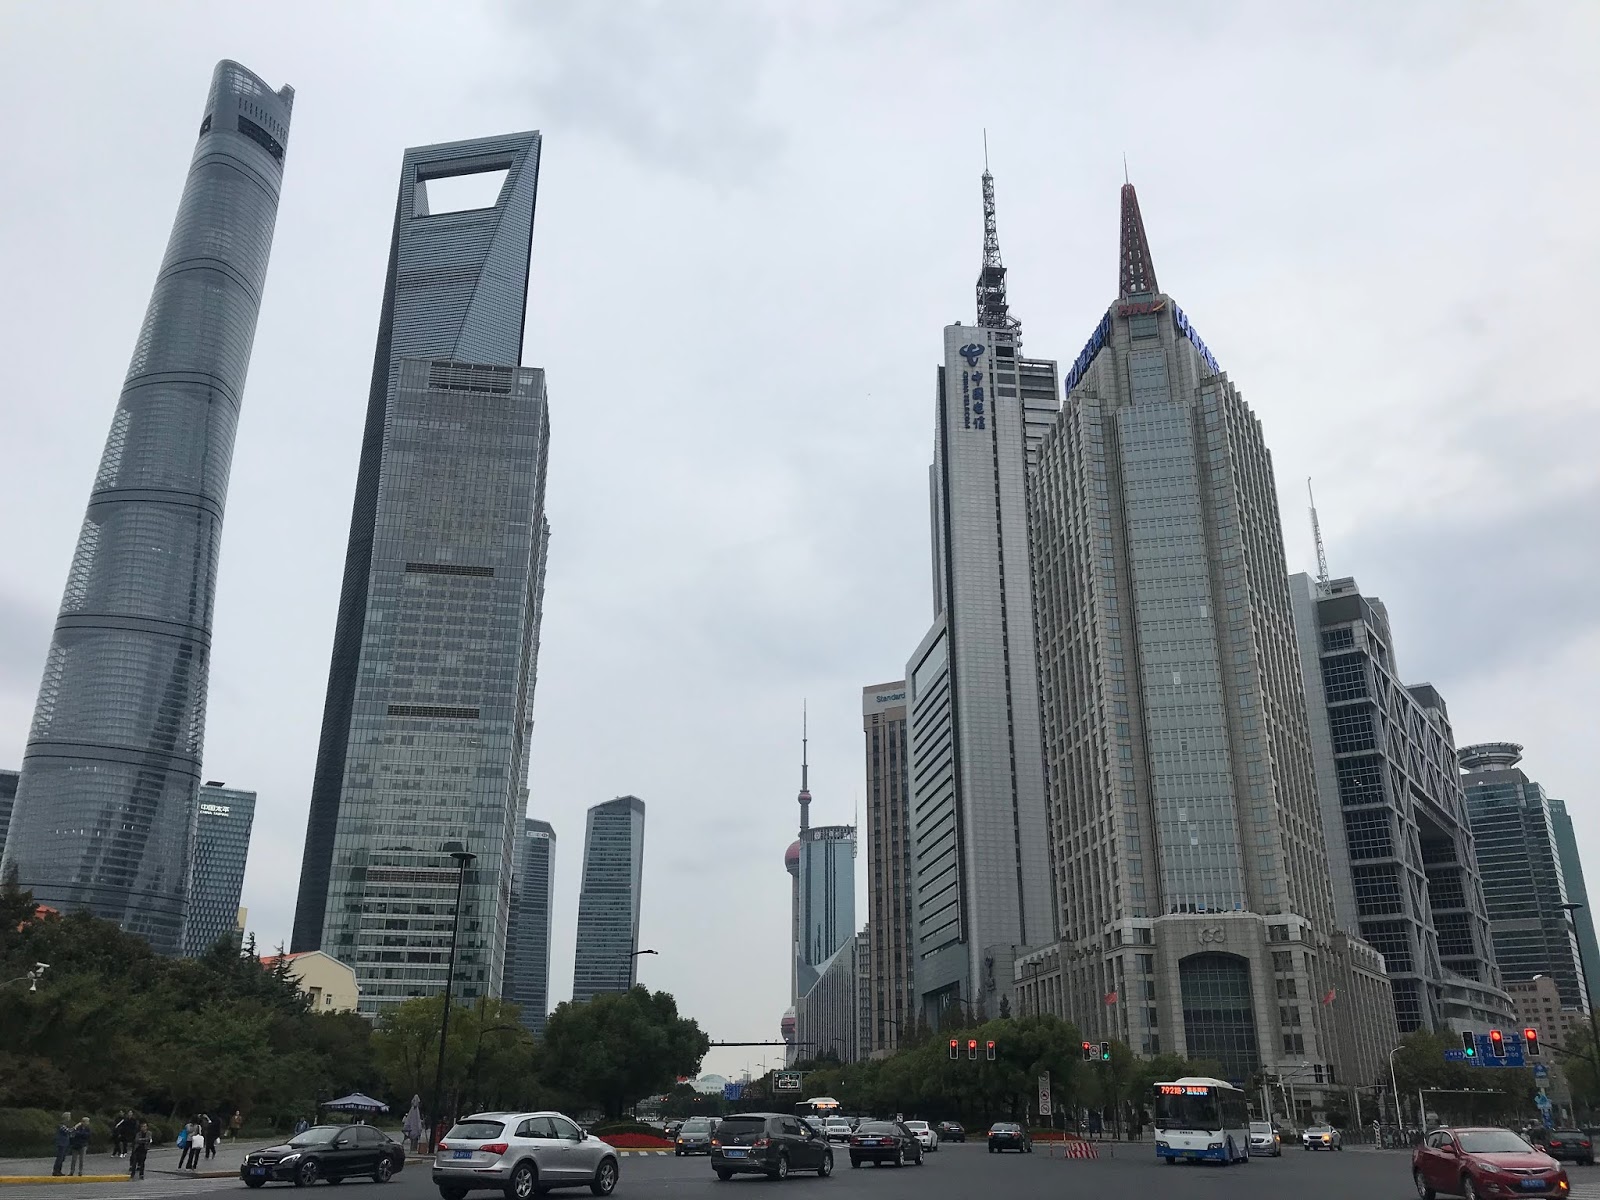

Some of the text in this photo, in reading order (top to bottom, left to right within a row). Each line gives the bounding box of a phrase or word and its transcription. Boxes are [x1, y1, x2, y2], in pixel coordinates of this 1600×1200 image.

[971, 371, 985, 430] 中国电信
[876, 692, 905, 702] Standard
